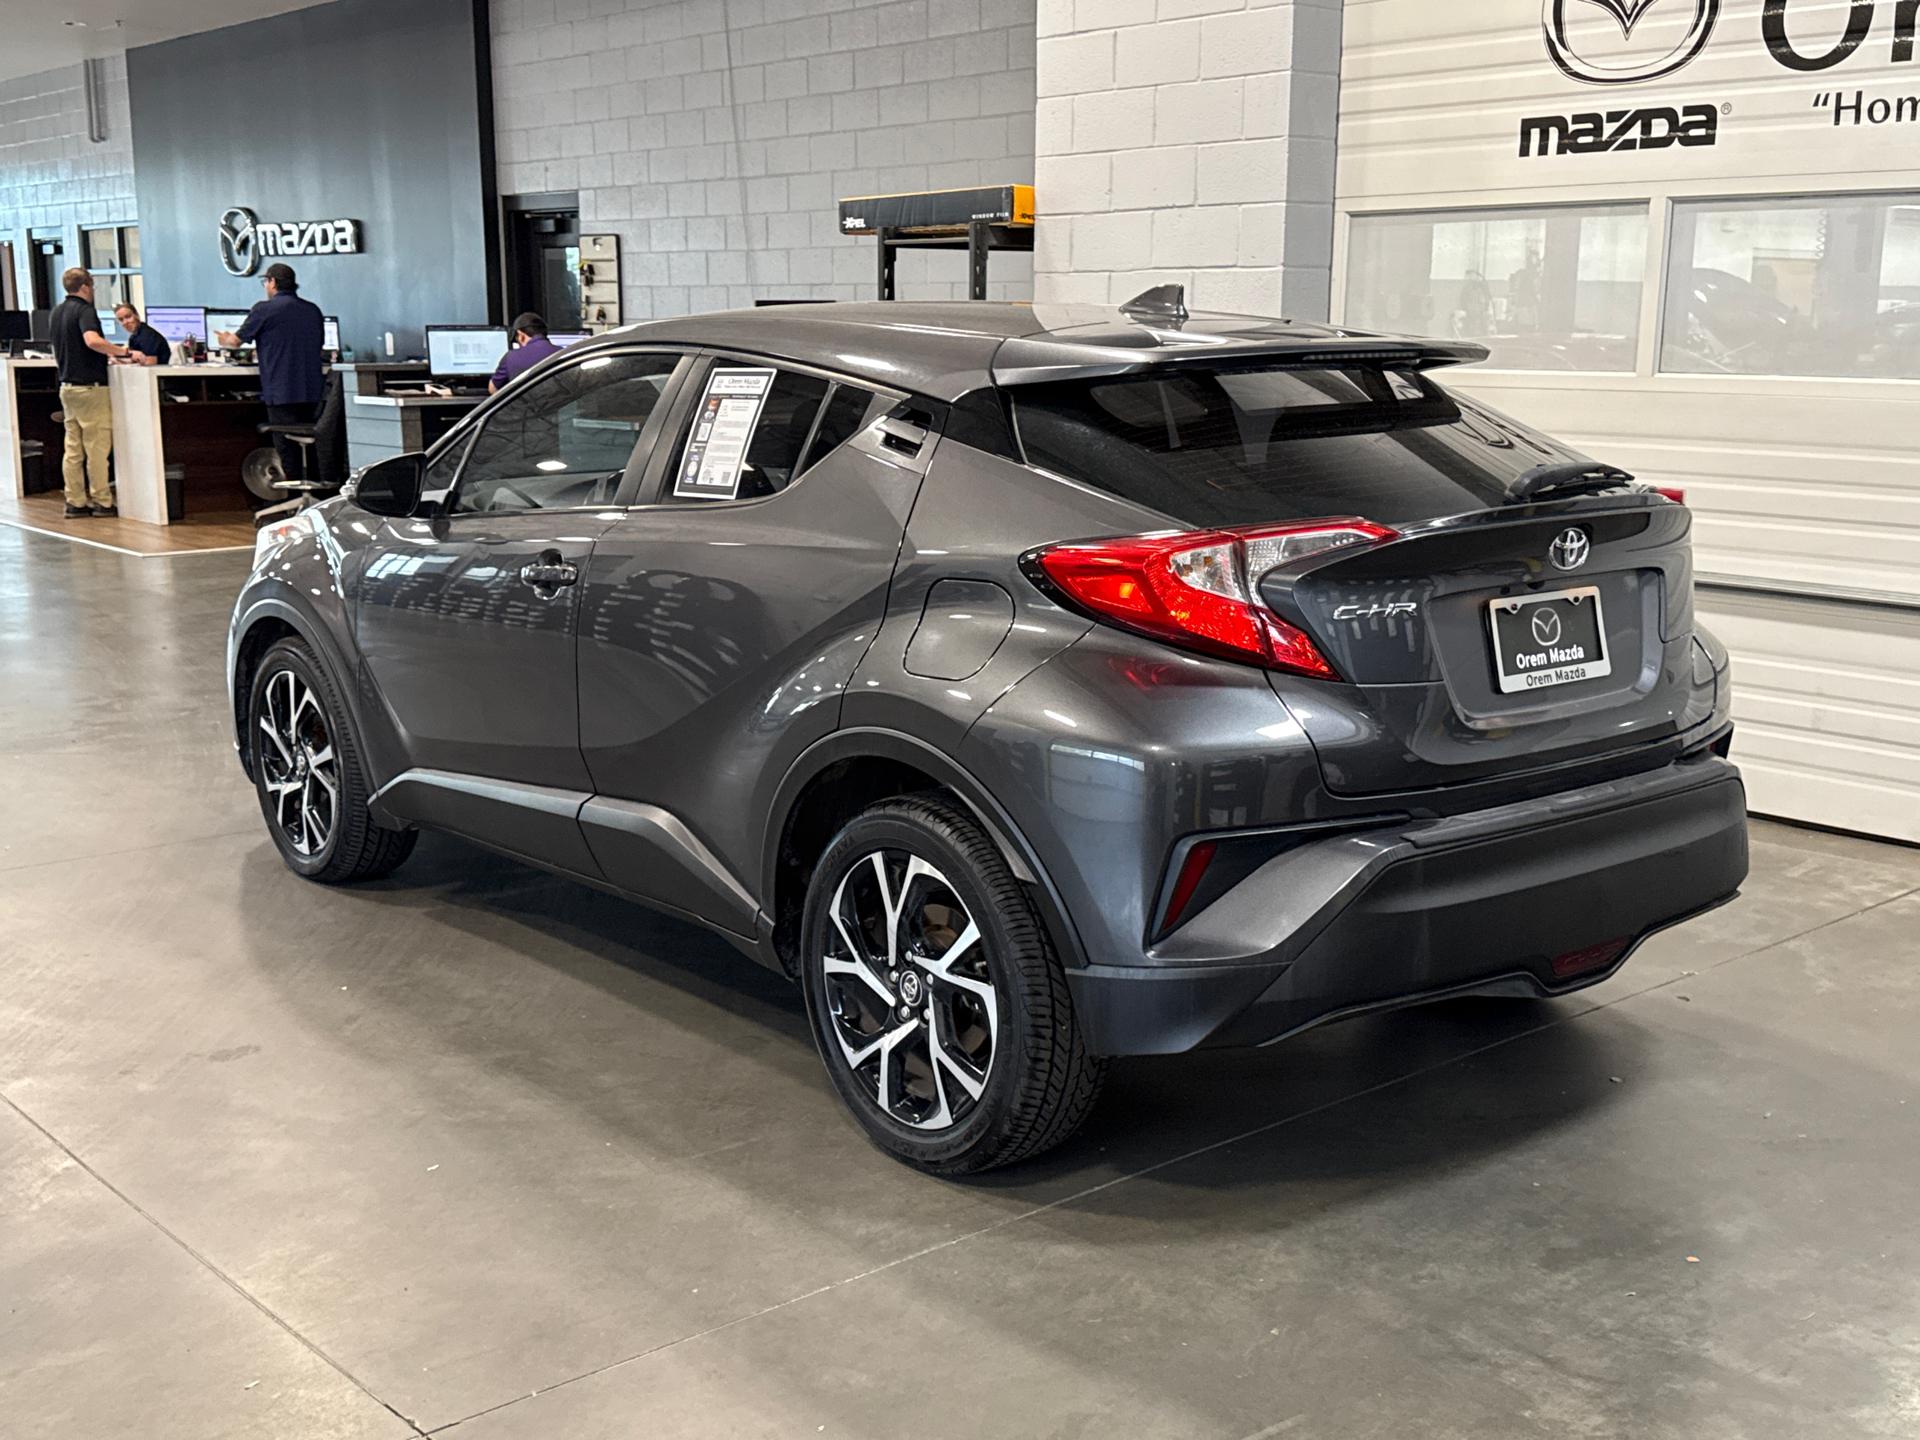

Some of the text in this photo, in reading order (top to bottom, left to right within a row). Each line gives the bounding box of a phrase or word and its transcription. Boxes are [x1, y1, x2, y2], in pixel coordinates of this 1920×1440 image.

[1518, 104, 1718, 158] mazda
[842, 216, 867, 229] XPEL
[971, 212, 995, 220] WINDOW
[256, 219, 358, 256] mazda
[1332, 602, 1418, 621] C-HR
[1516, 644, 1585, 669] Orem Mazda
[1526, 666, 1587, 688] Orem Mazda
